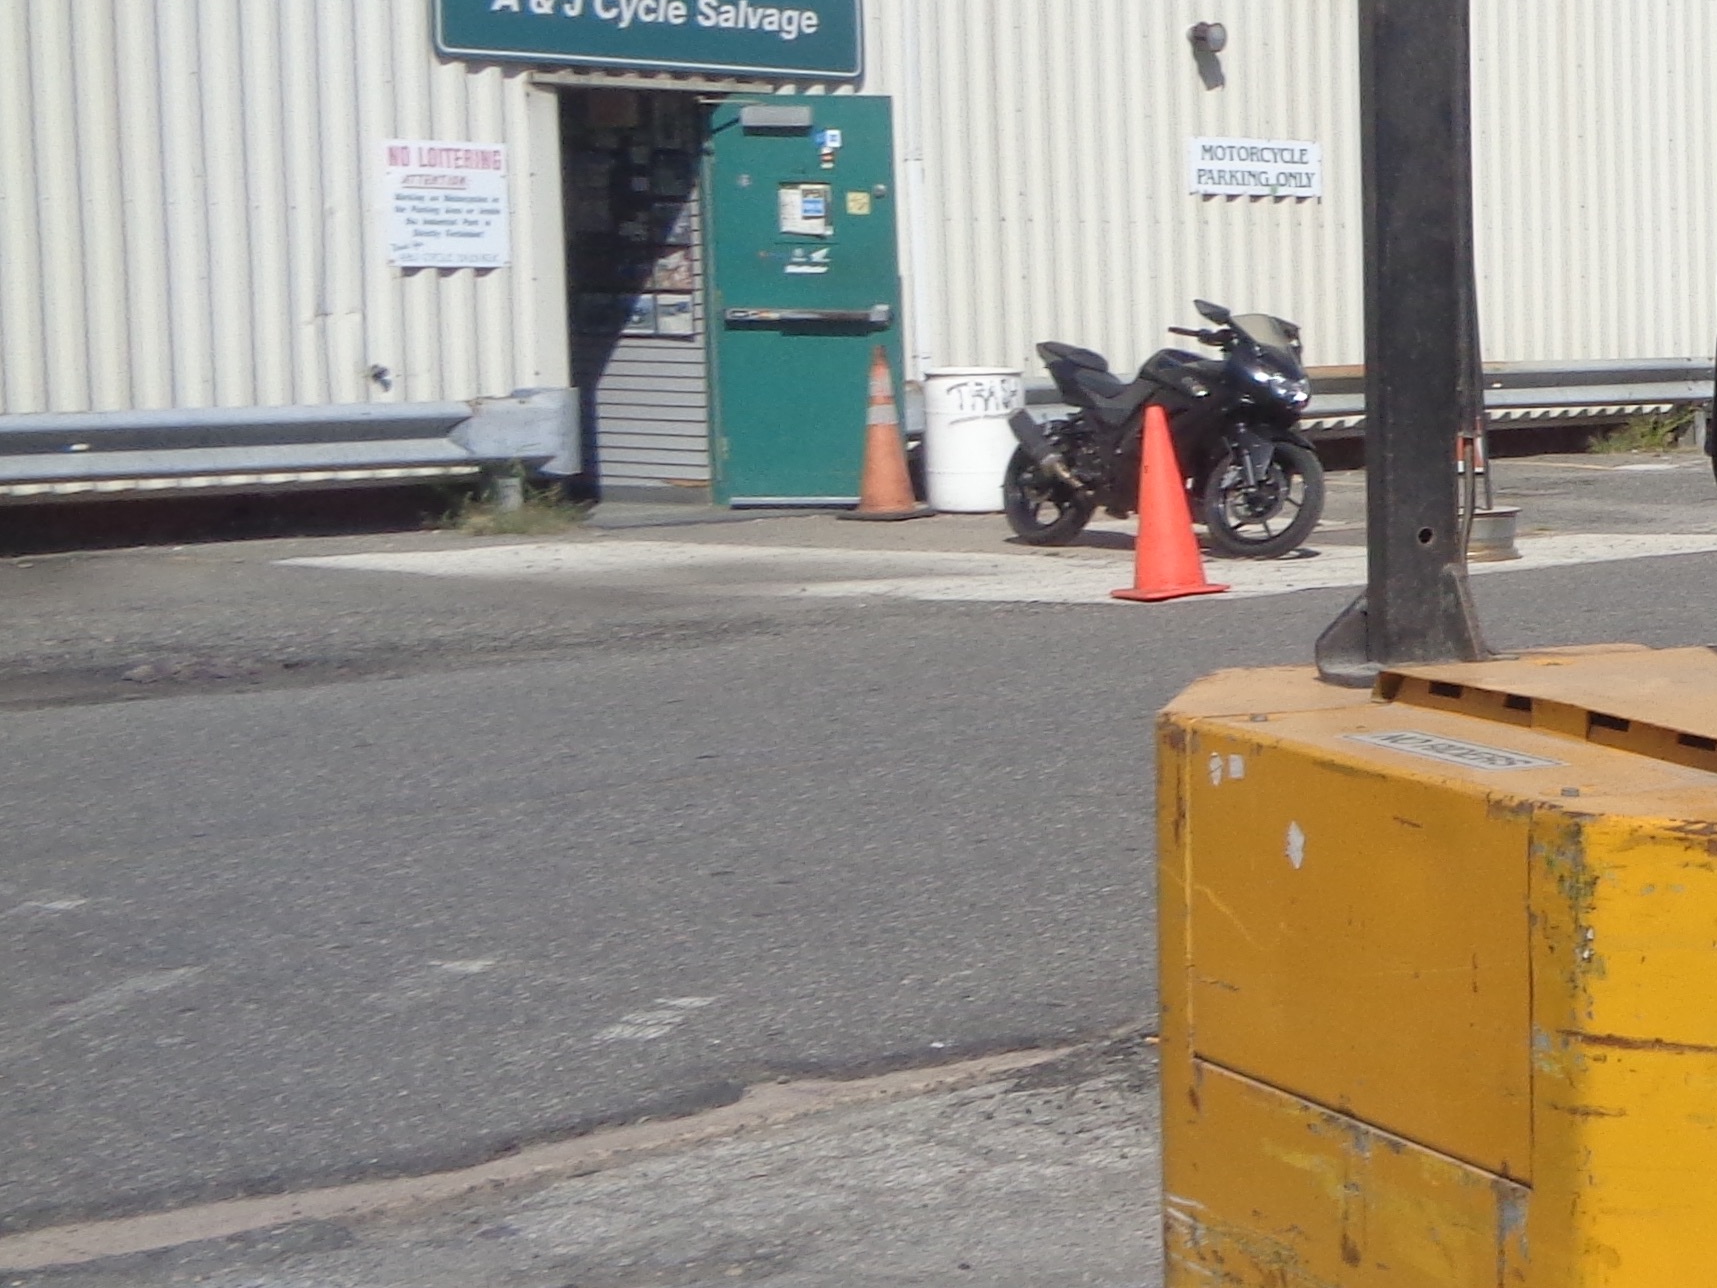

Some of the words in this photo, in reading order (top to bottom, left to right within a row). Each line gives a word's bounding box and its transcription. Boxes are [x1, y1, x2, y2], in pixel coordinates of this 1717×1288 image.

[388, 146, 409, 166] NO
[419, 147, 501, 170] LOITERING
[1202, 145, 1308, 164] MOTORCYCLE
[1197, 169, 1268, 186] PARKING
[1277, 172, 1316, 188] ONLY
